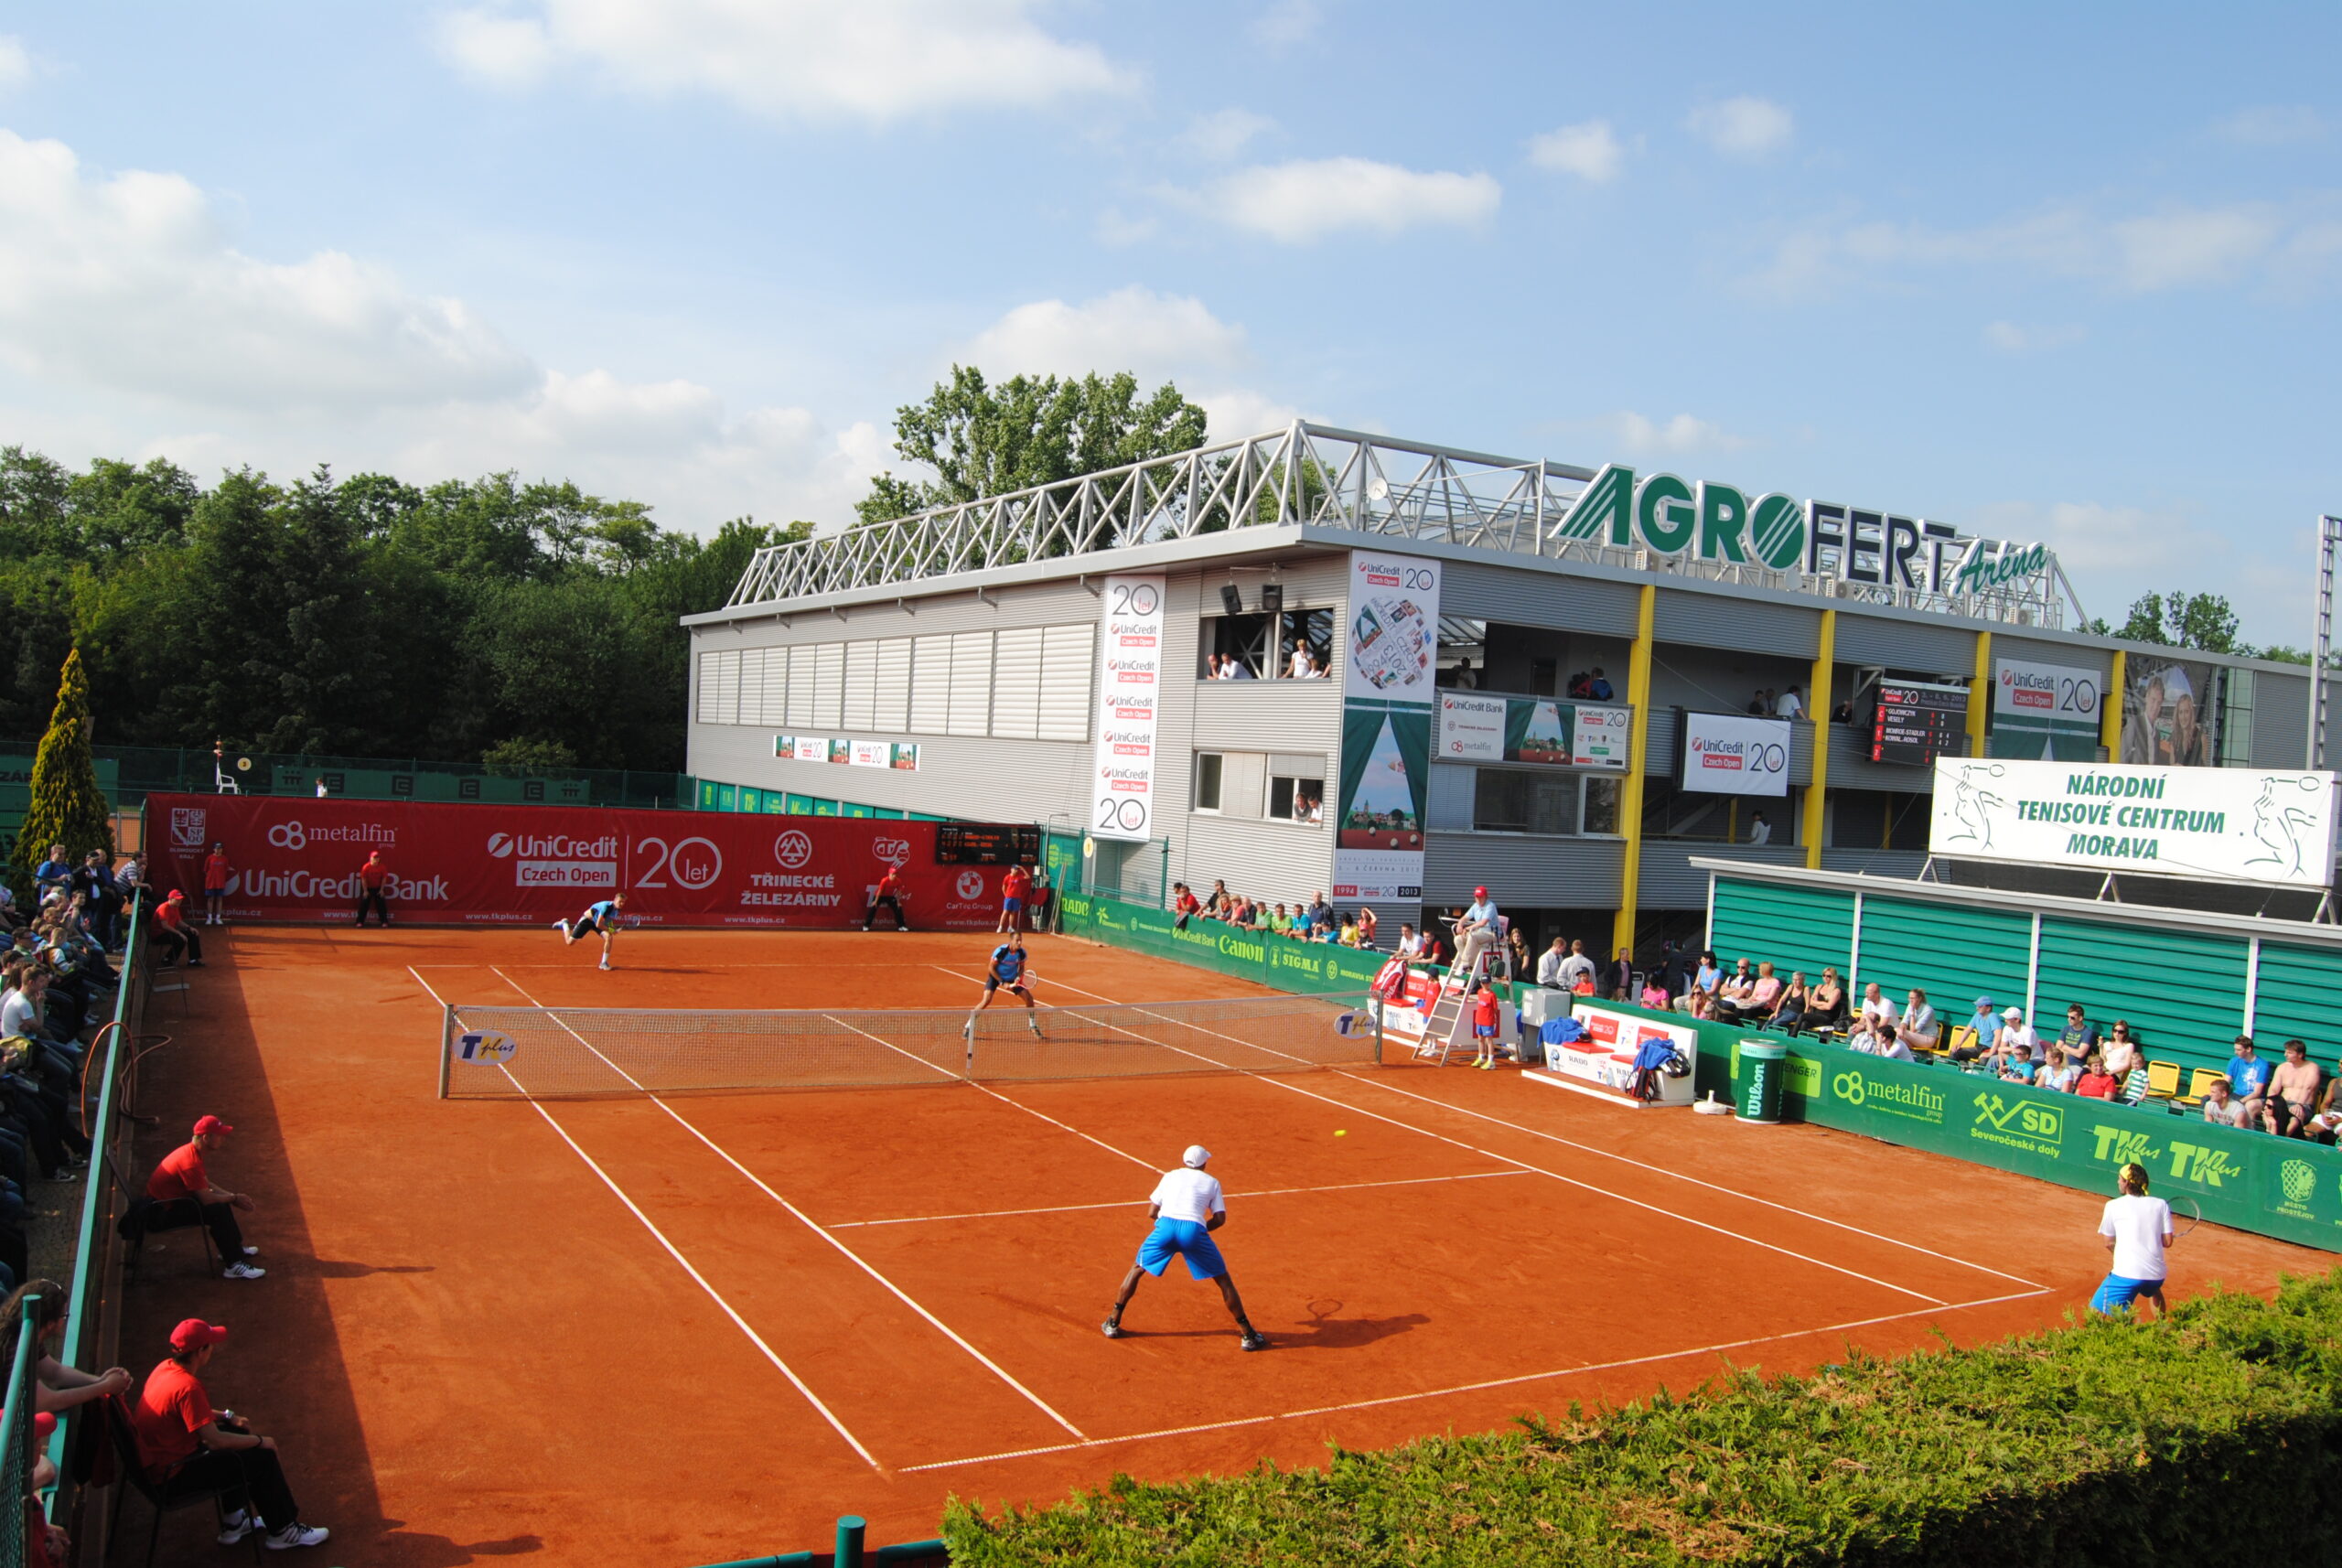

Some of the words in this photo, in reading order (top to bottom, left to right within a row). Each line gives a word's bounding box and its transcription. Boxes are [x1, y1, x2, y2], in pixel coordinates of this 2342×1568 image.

[1548, 464, 1957, 595] AGROFERT
[1368, 564, 1400, 575] UniCredit
[1405, 568, 1434, 590] 20
[1112, 584, 1159, 616] 20
[1121, 624, 1156, 635] UniCredit
[1118, 660, 1155, 671] UniCredit
[1116, 696, 1153, 707] UniCredit
[2014, 671, 2054, 691] UniCredit
[2060, 677, 2096, 714] 20
[2014, 692, 2033, 704] Czech
[2034, 694, 2051, 708] Open
[1454, 700, 1485, 712] UniCredit
[1486, 703, 1503, 714] Bank
[1607, 712, 1626, 727] 20
[1113, 733, 1150, 743] UniCredit
[1703, 739, 1743, 755] UniCredit
[1749, 743, 1785, 773] 20
[1704, 757, 1723, 767] Czech
[1724, 758, 1740, 768] Open
[1112, 768, 1148, 779] UniCredit
[2067, 770, 2168, 799] NÁRODNÍ
[1100, 798, 1145, 831] 20
[1125, 812, 1138, 826] let
[2018, 800, 2112, 825] TENISOVÉ
[2117, 806, 2225, 833] CENTRUM
[310, 823, 395, 842] metalfin
[2066, 833, 2159, 860] MORAVA
[517, 834, 618, 858] UniCredit
[635, 837, 723, 890] 20
[685, 858, 708, 881] let
[245, 870, 362, 898] UniCredi
[384, 872, 449, 900] Bank
[521, 867, 564, 882] Czech
[570, 867, 609, 883] Open
[750, 874, 834, 888] TŘINECKÉ
[740, 891, 842, 907] ŽELEZÁRNY
[1061, 897, 1089, 917] RADO
[466, 912, 532, 921] www.tkplus.cz
[725, 915, 786, 924] www.tkplus.cz
[1176, 928, 1201, 944] UniCredit
[1201, 934, 1216, 948] Bank
[1219, 935, 1264, 962] Canon
[1283, 954, 1319, 972] SIGMA
[480, 1038, 515, 1056] plus
[1569, 1055, 1588, 1066] RADO
[1747, 1062, 1766, 1116] Wilson
[1867, 1081, 1943, 1111] metalfin
[1926, 1110, 1943, 1119] group
[2022, 1108, 2057, 1135] SD
[1971, 1127, 2036, 1151] Severočeské
[2037, 1144, 2060, 1159] doly
[2169, 1141, 2230, 1187] TK
[2195, 1150, 2241, 1177] plus
